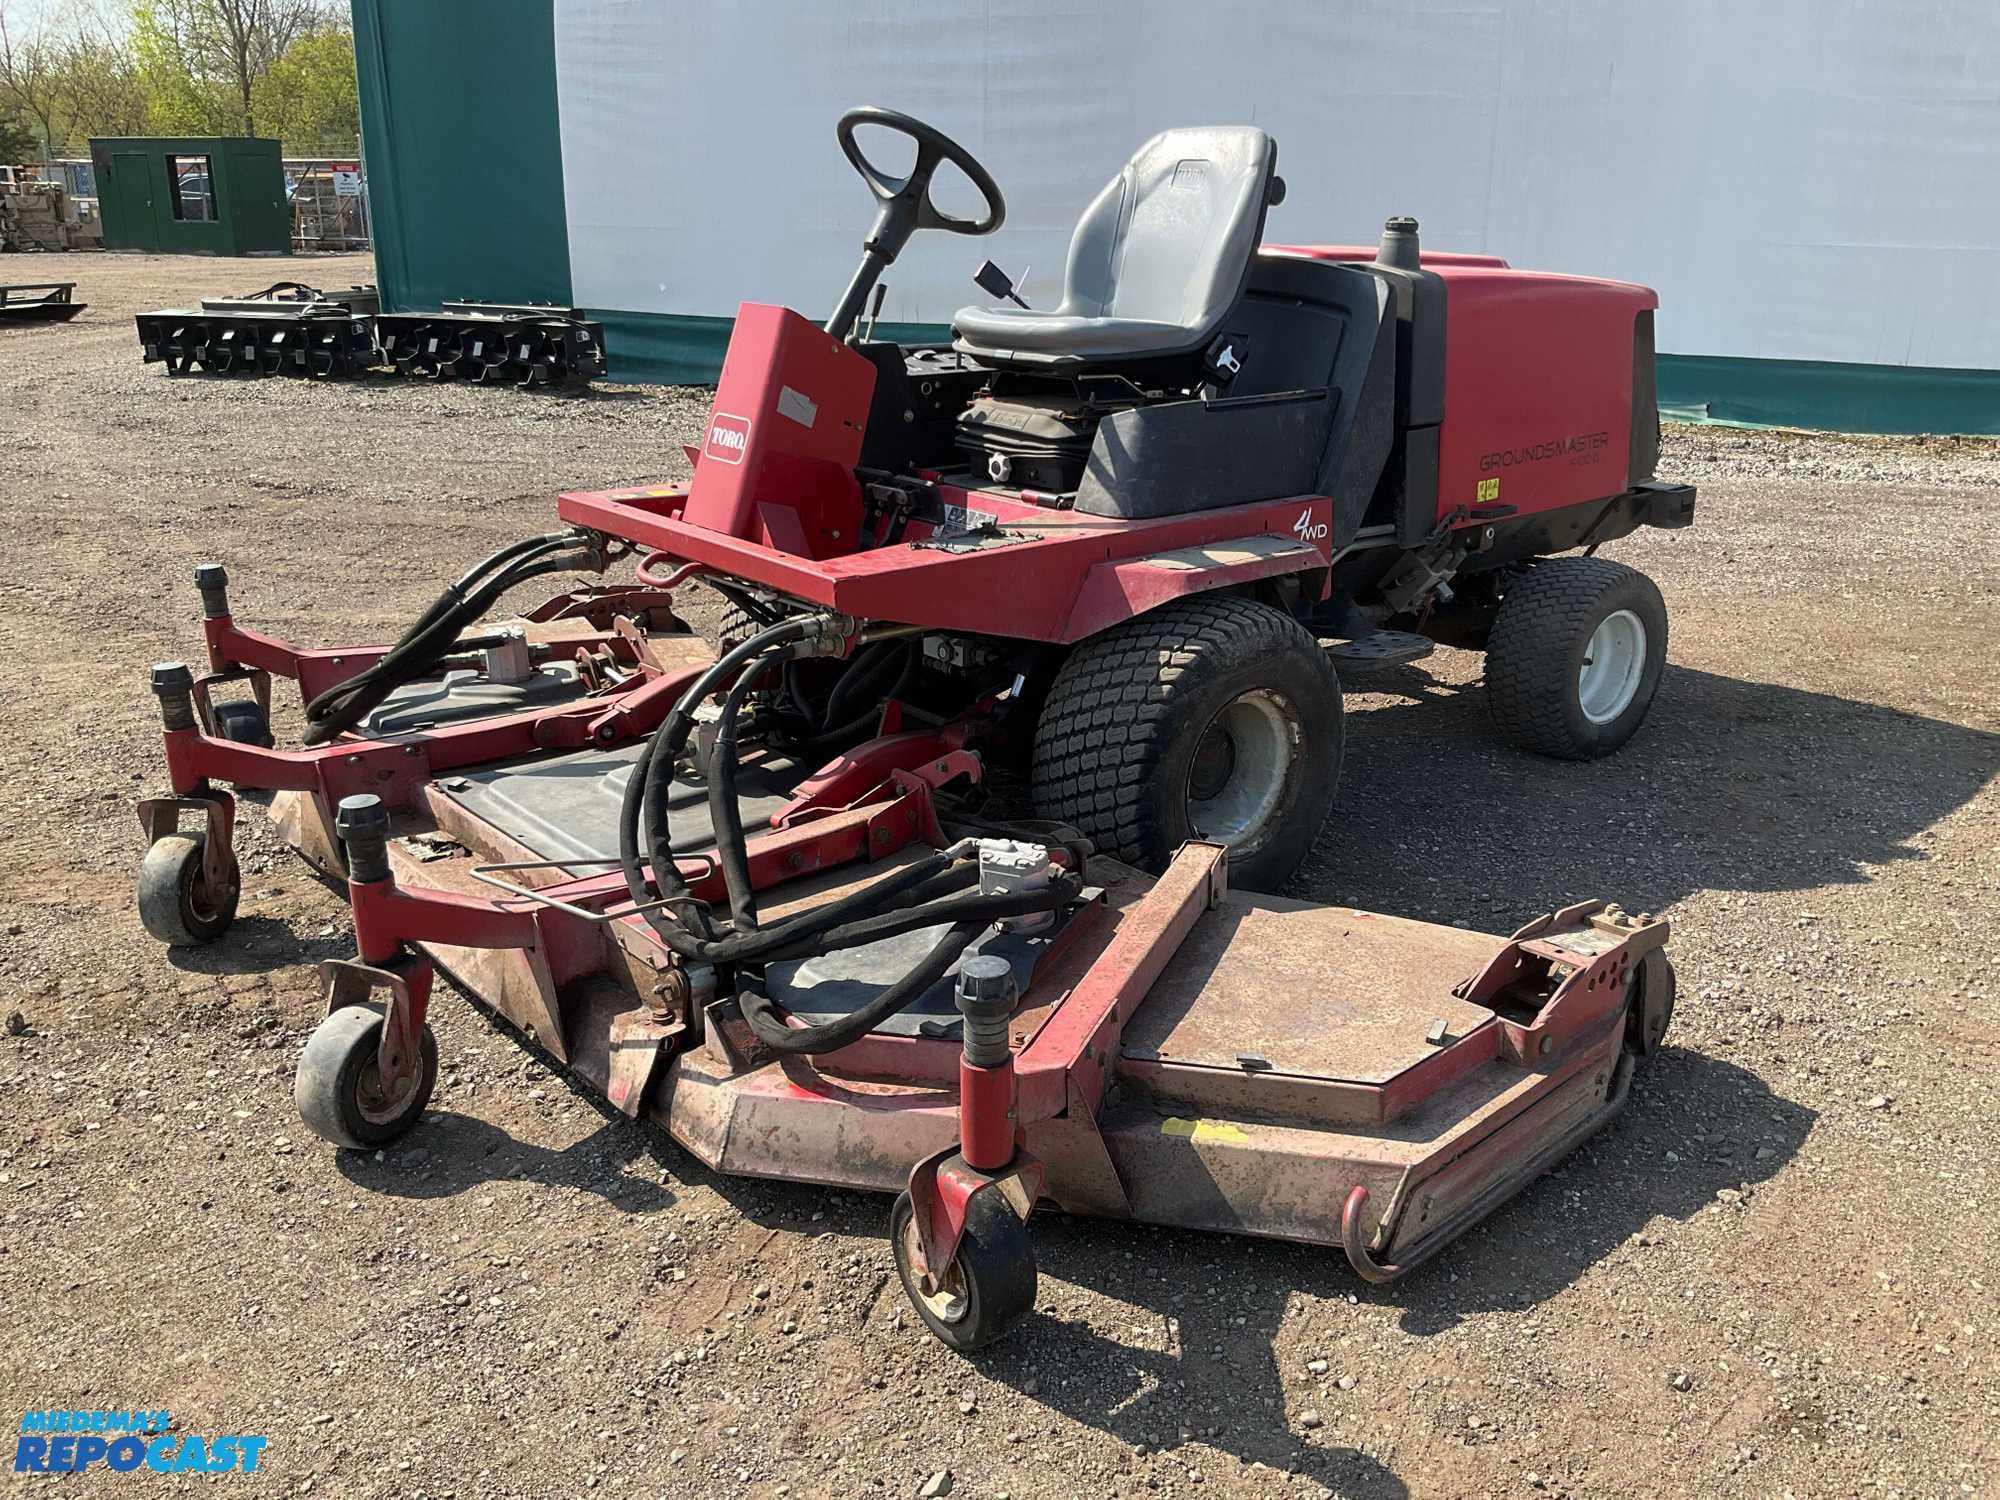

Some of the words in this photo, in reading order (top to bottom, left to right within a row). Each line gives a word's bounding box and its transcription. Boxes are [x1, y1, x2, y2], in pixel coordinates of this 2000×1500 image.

[712, 426, 744, 450] TORO
[1479, 431, 1609, 472] GROUNDSMASTER
[1293, 506, 1328, 541] 4WD
